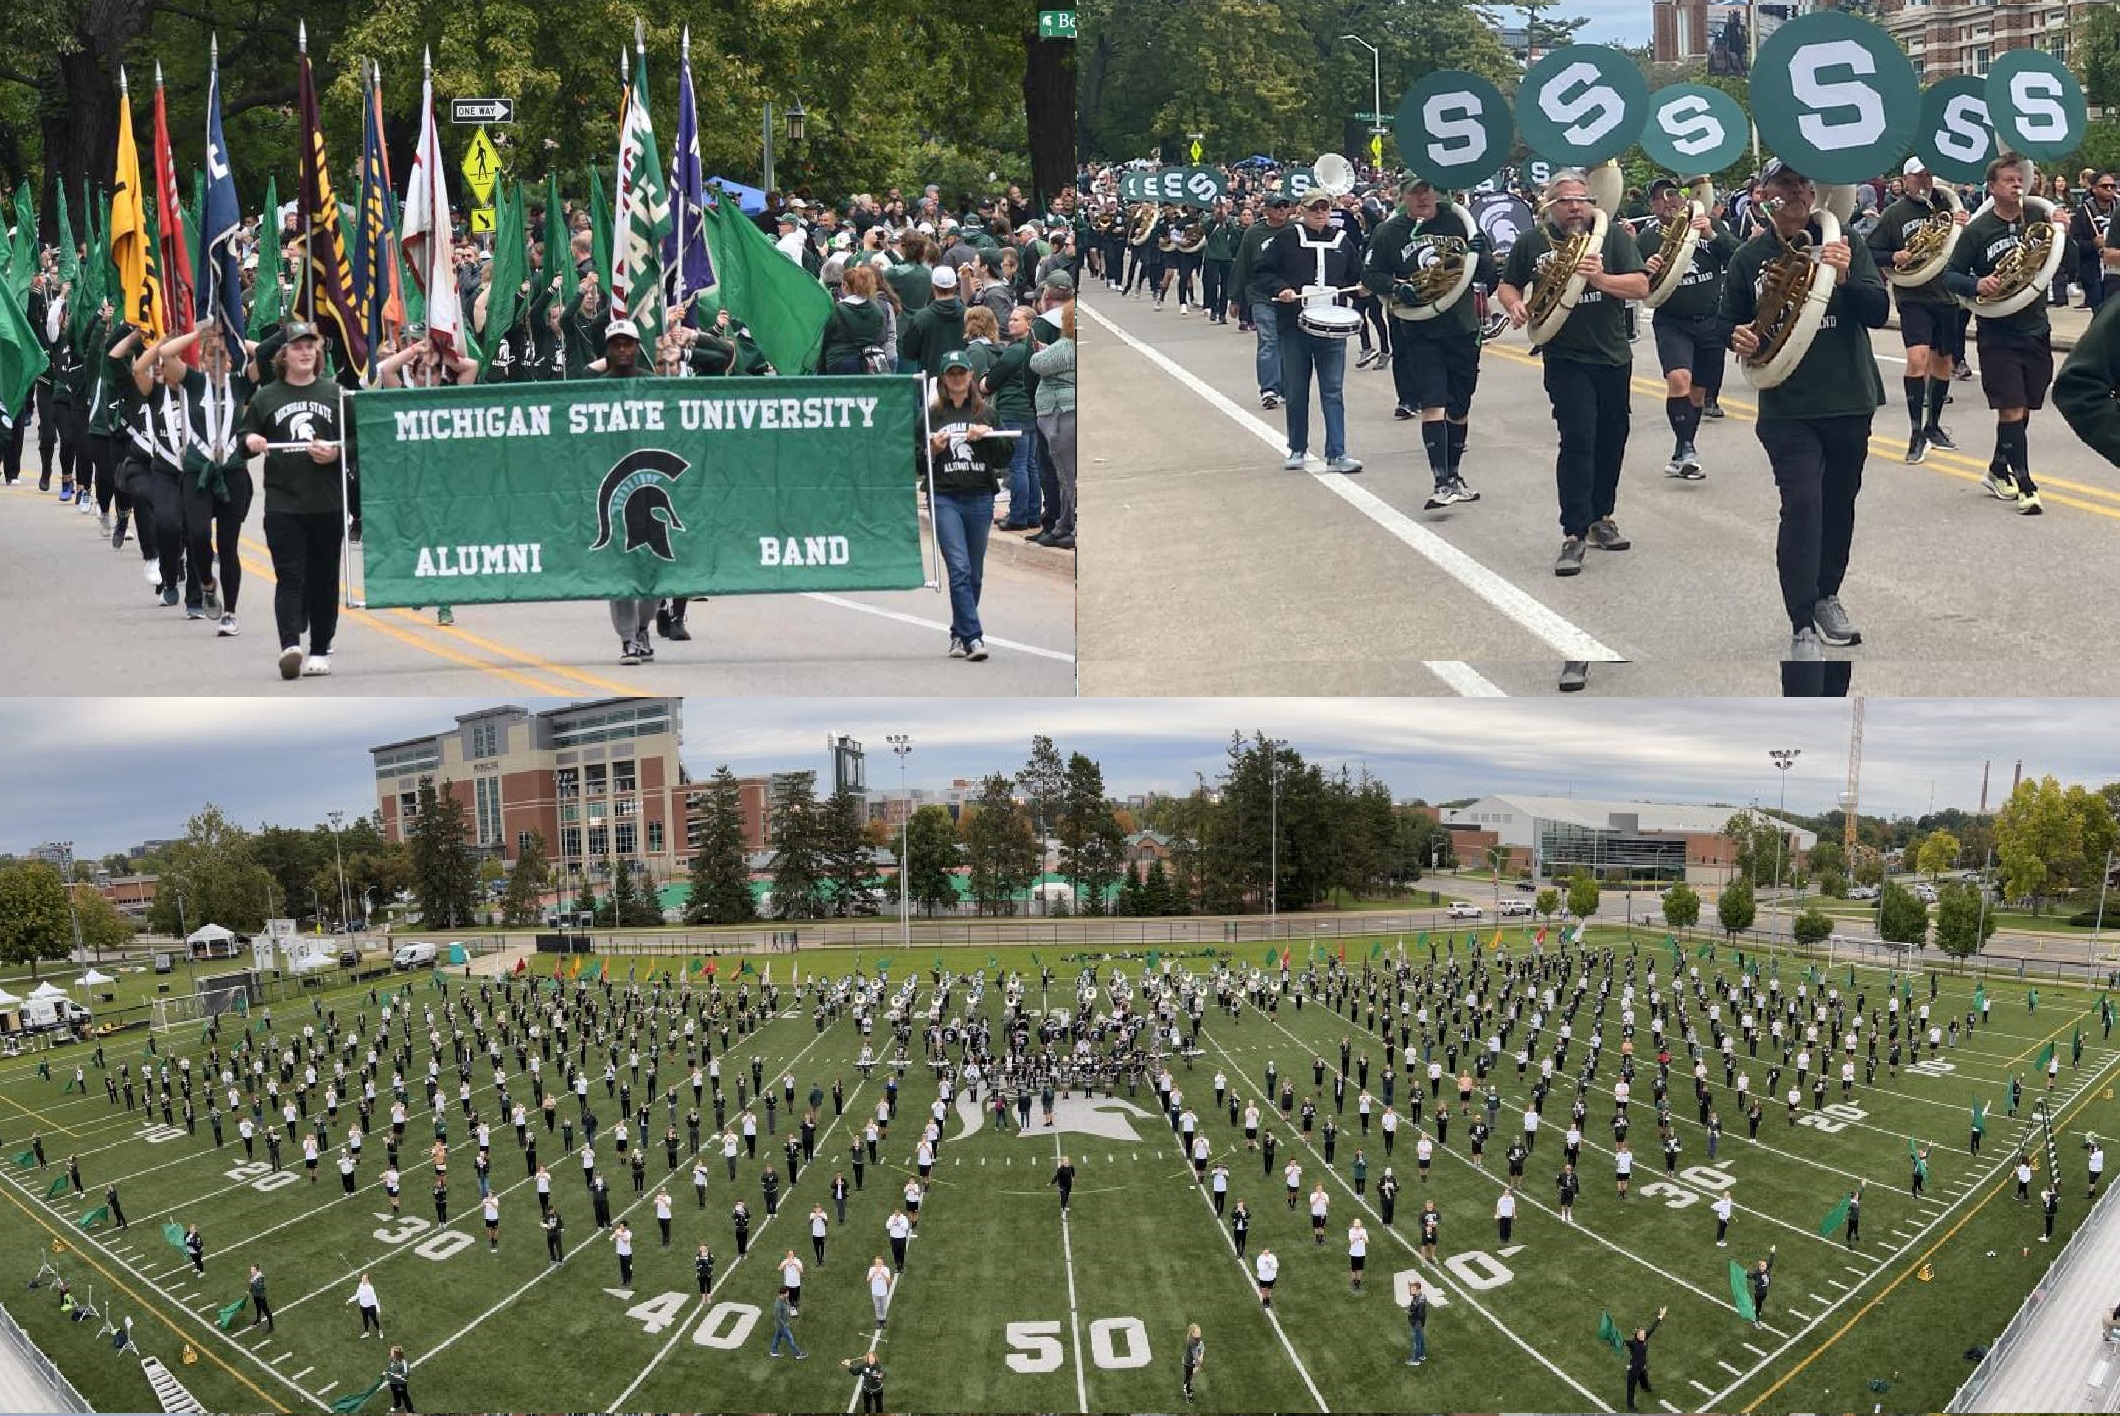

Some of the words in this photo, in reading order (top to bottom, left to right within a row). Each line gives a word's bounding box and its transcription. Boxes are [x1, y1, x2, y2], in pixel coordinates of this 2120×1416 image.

[458, 106, 476, 116] ONE
[479, 106, 496, 116] WAY
[1539, 62, 1626, 146] S
[1788, 39, 1886, 151] S
[2009, 72, 2069, 141] S
[1423, 90, 1487, 167] S
[1657, 95, 1725, 156] S
[1934, 94, 1994, 163] S
[1187, 172, 1218, 201] S
[1290, 174, 1311, 197] S
[1531, 161, 1550, 184] S
[309, 401, 333, 424] STATE
[394, 405, 551, 441] MICHIGAN
[569, 400, 664, 434] STATE
[679, 397, 878, 430] UNIVERSITY
[415, 544, 542, 577] ALUMNI
[759, 536, 849, 566] BAND
[1797, 1104, 1869, 1133] 20
[224, 1161, 300, 1192] 20
[1640, 1166, 1736, 1208] 30
[373, 1216, 475, 1260] 30
[626, 1291, 761, 1349] 40
[1006, 1316, 1152, 1373] 50
